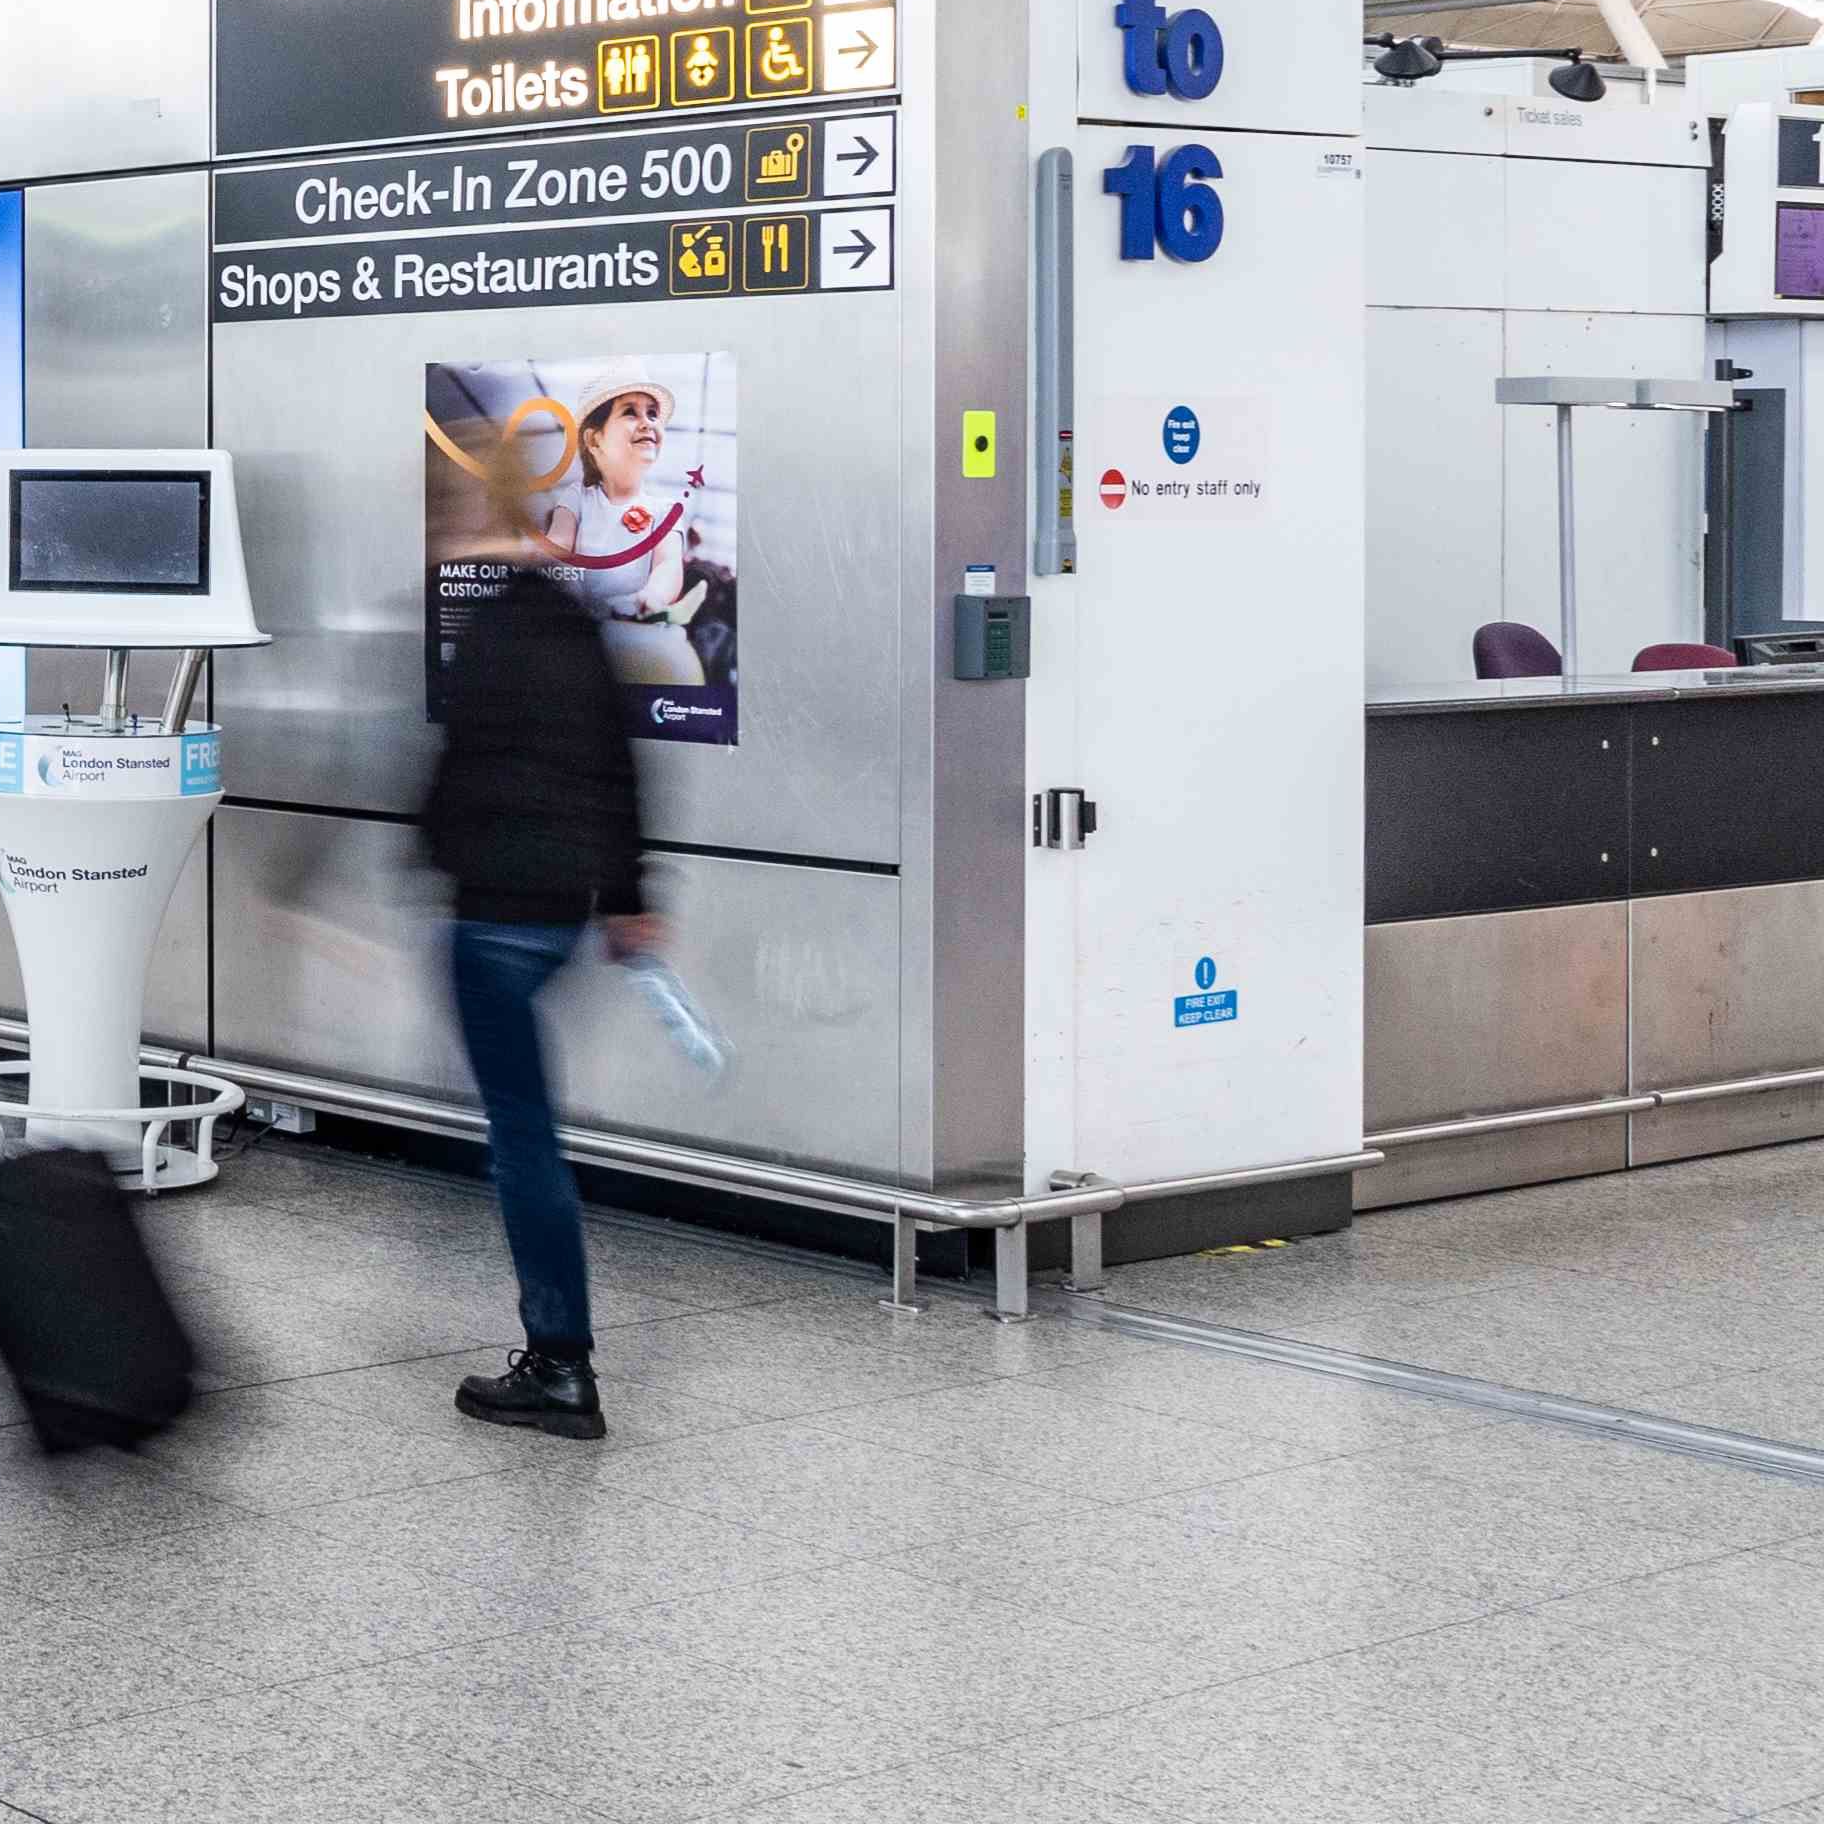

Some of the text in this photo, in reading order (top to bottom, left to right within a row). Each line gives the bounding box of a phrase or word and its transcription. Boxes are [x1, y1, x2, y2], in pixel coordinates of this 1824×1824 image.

[435, 59, 588, 118] Toilets
[295, 142, 733, 226] Check-In Zone 500
[1103, 143, 1224, 263] 16
[219, 242, 659, 314] Shops & Restaurants
[1131, 480, 1261, 499] No entry staff only
[440, 564, 477, 578] MAKE
[480, 565, 509, 579] OUR
[62, 757, 170, 769] London Stansted
[62, 772, 105, 783] Airport
[8, 862, 148, 881] London Stansted
[13, 877, 59, 894] Airport
[1185, 994, 1226, 1009] FIRE EXIT
[1179, 1007, 1233, 1025] KEEP CLEAR
